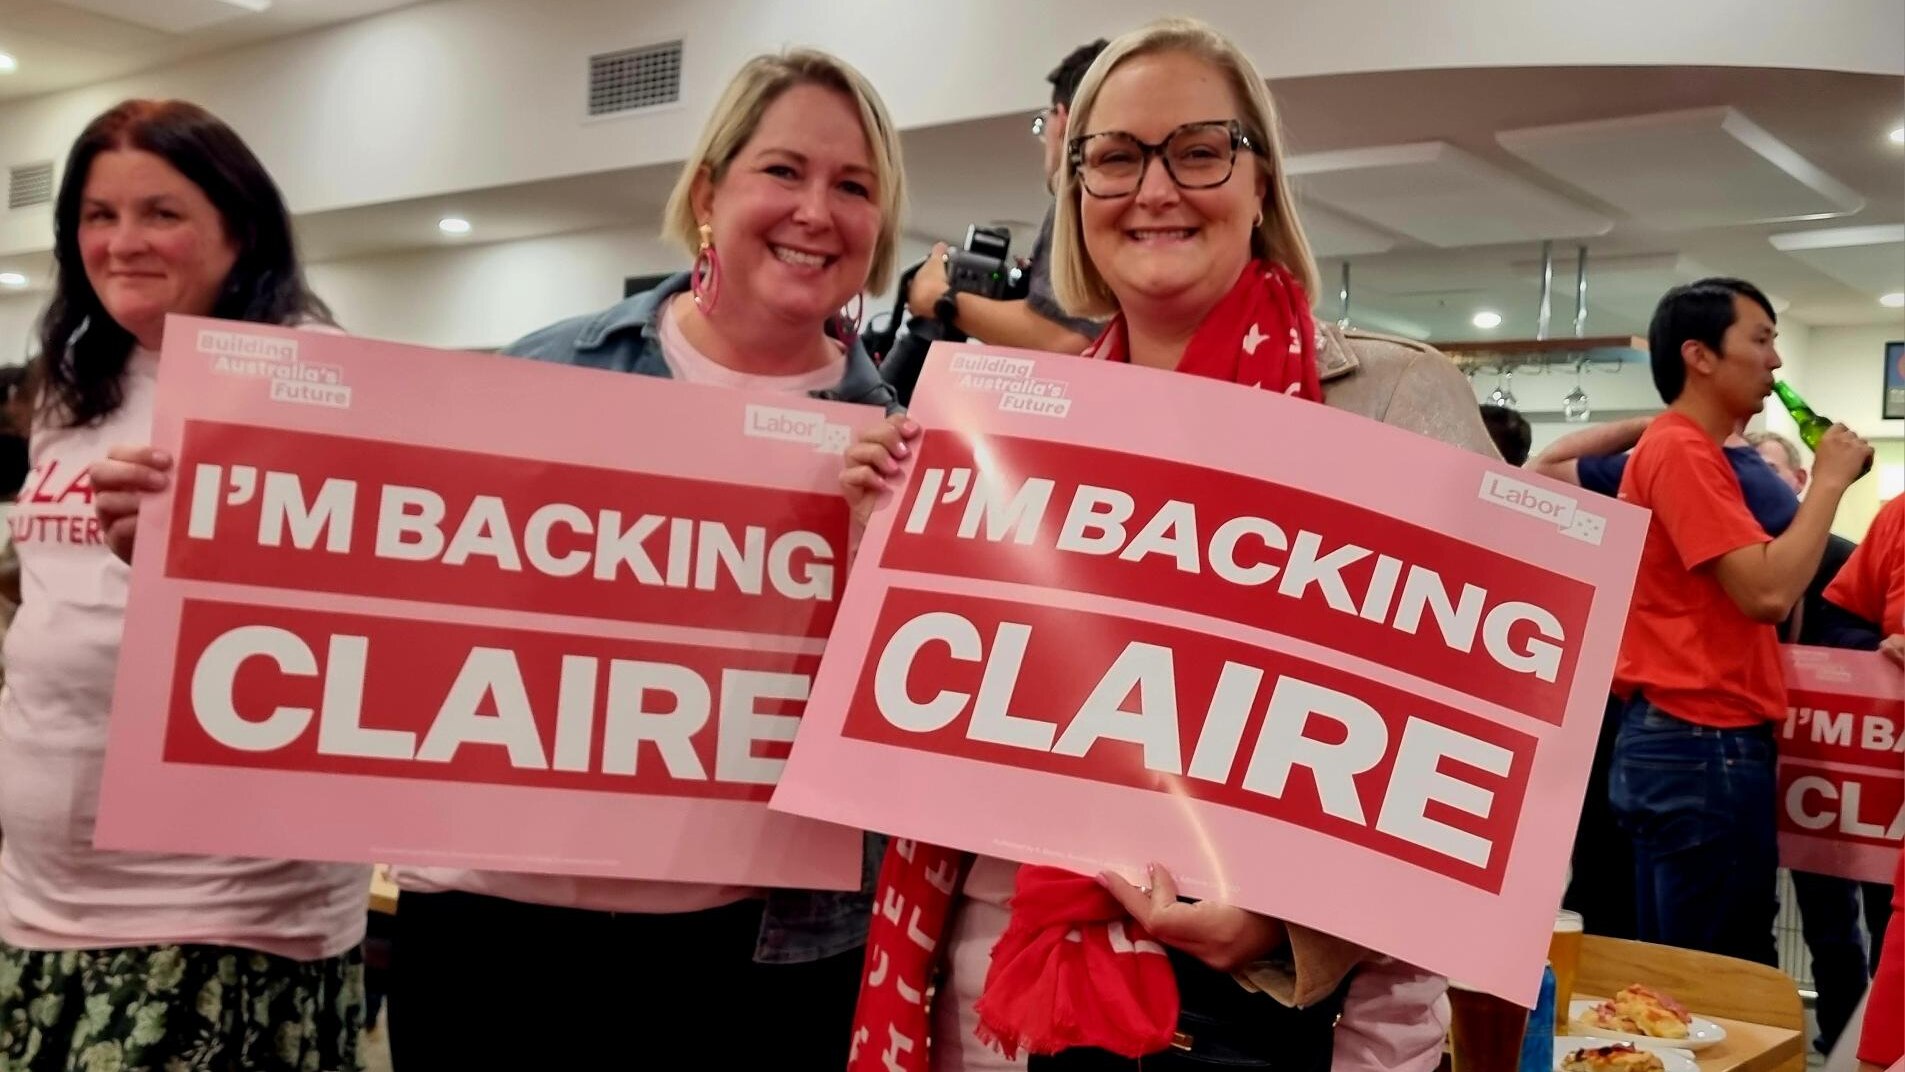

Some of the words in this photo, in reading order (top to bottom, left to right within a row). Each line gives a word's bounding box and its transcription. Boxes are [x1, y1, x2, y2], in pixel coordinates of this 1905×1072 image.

[201, 333, 293, 361] Building
[214, 355, 338, 384] Australia's
[953, 357, 1031, 375] Building
[275, 382, 347, 403] Future
[961, 374, 1062, 397] Australia's
[1003, 396, 1066, 414] Future
[752, 411, 816, 436] Labor
[1489, 479, 1567, 518] Labor
[188, 463, 357, 554] I'M
[375, 484, 834, 601] BACKING
[904, 467, 1056, 545] I'M
[1055, 484, 1566, 683] BACKING
[191, 625, 811, 785] CLAIRE
[874, 611, 1515, 870] CLAIRE
[1782, 707, 1854, 747] I'M
